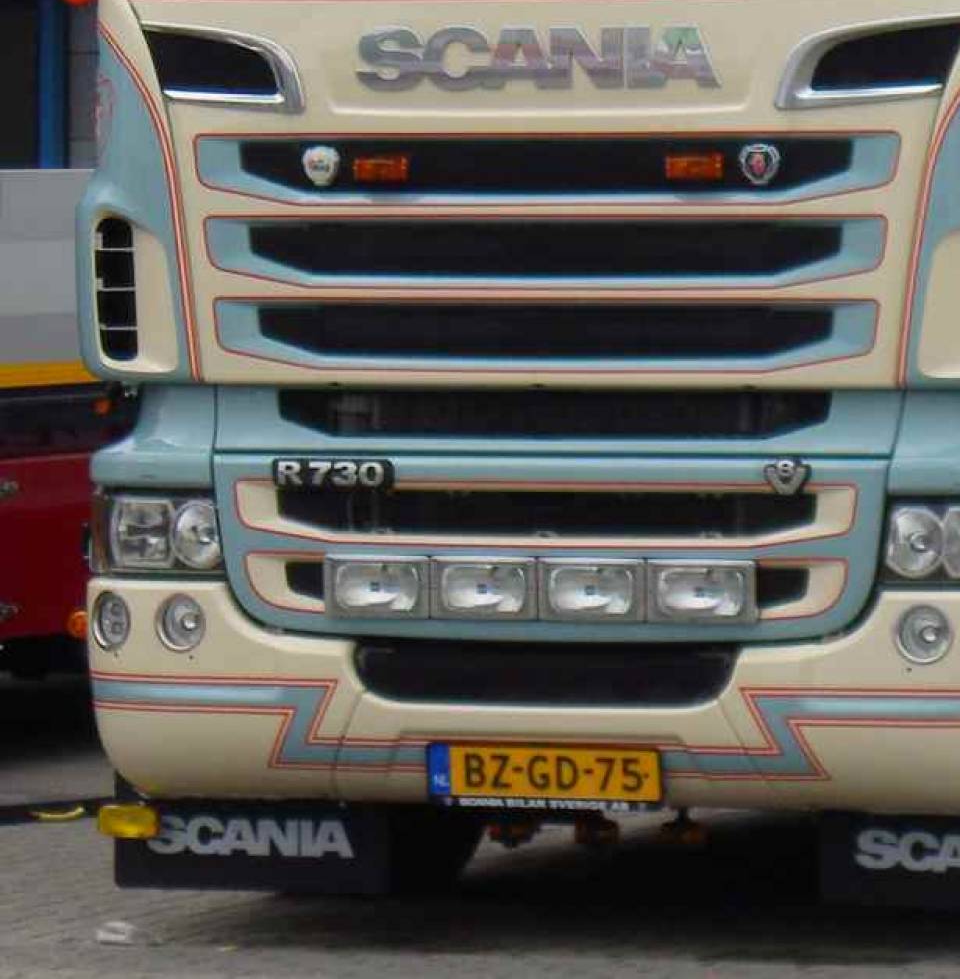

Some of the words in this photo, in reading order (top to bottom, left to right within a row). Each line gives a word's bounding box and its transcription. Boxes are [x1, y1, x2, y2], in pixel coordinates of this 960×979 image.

[356, 24, 722, 92] SCANIA
[463, 753, 644, 793] BZ-GD-75
[147, 814, 354, 859] SCANIA
